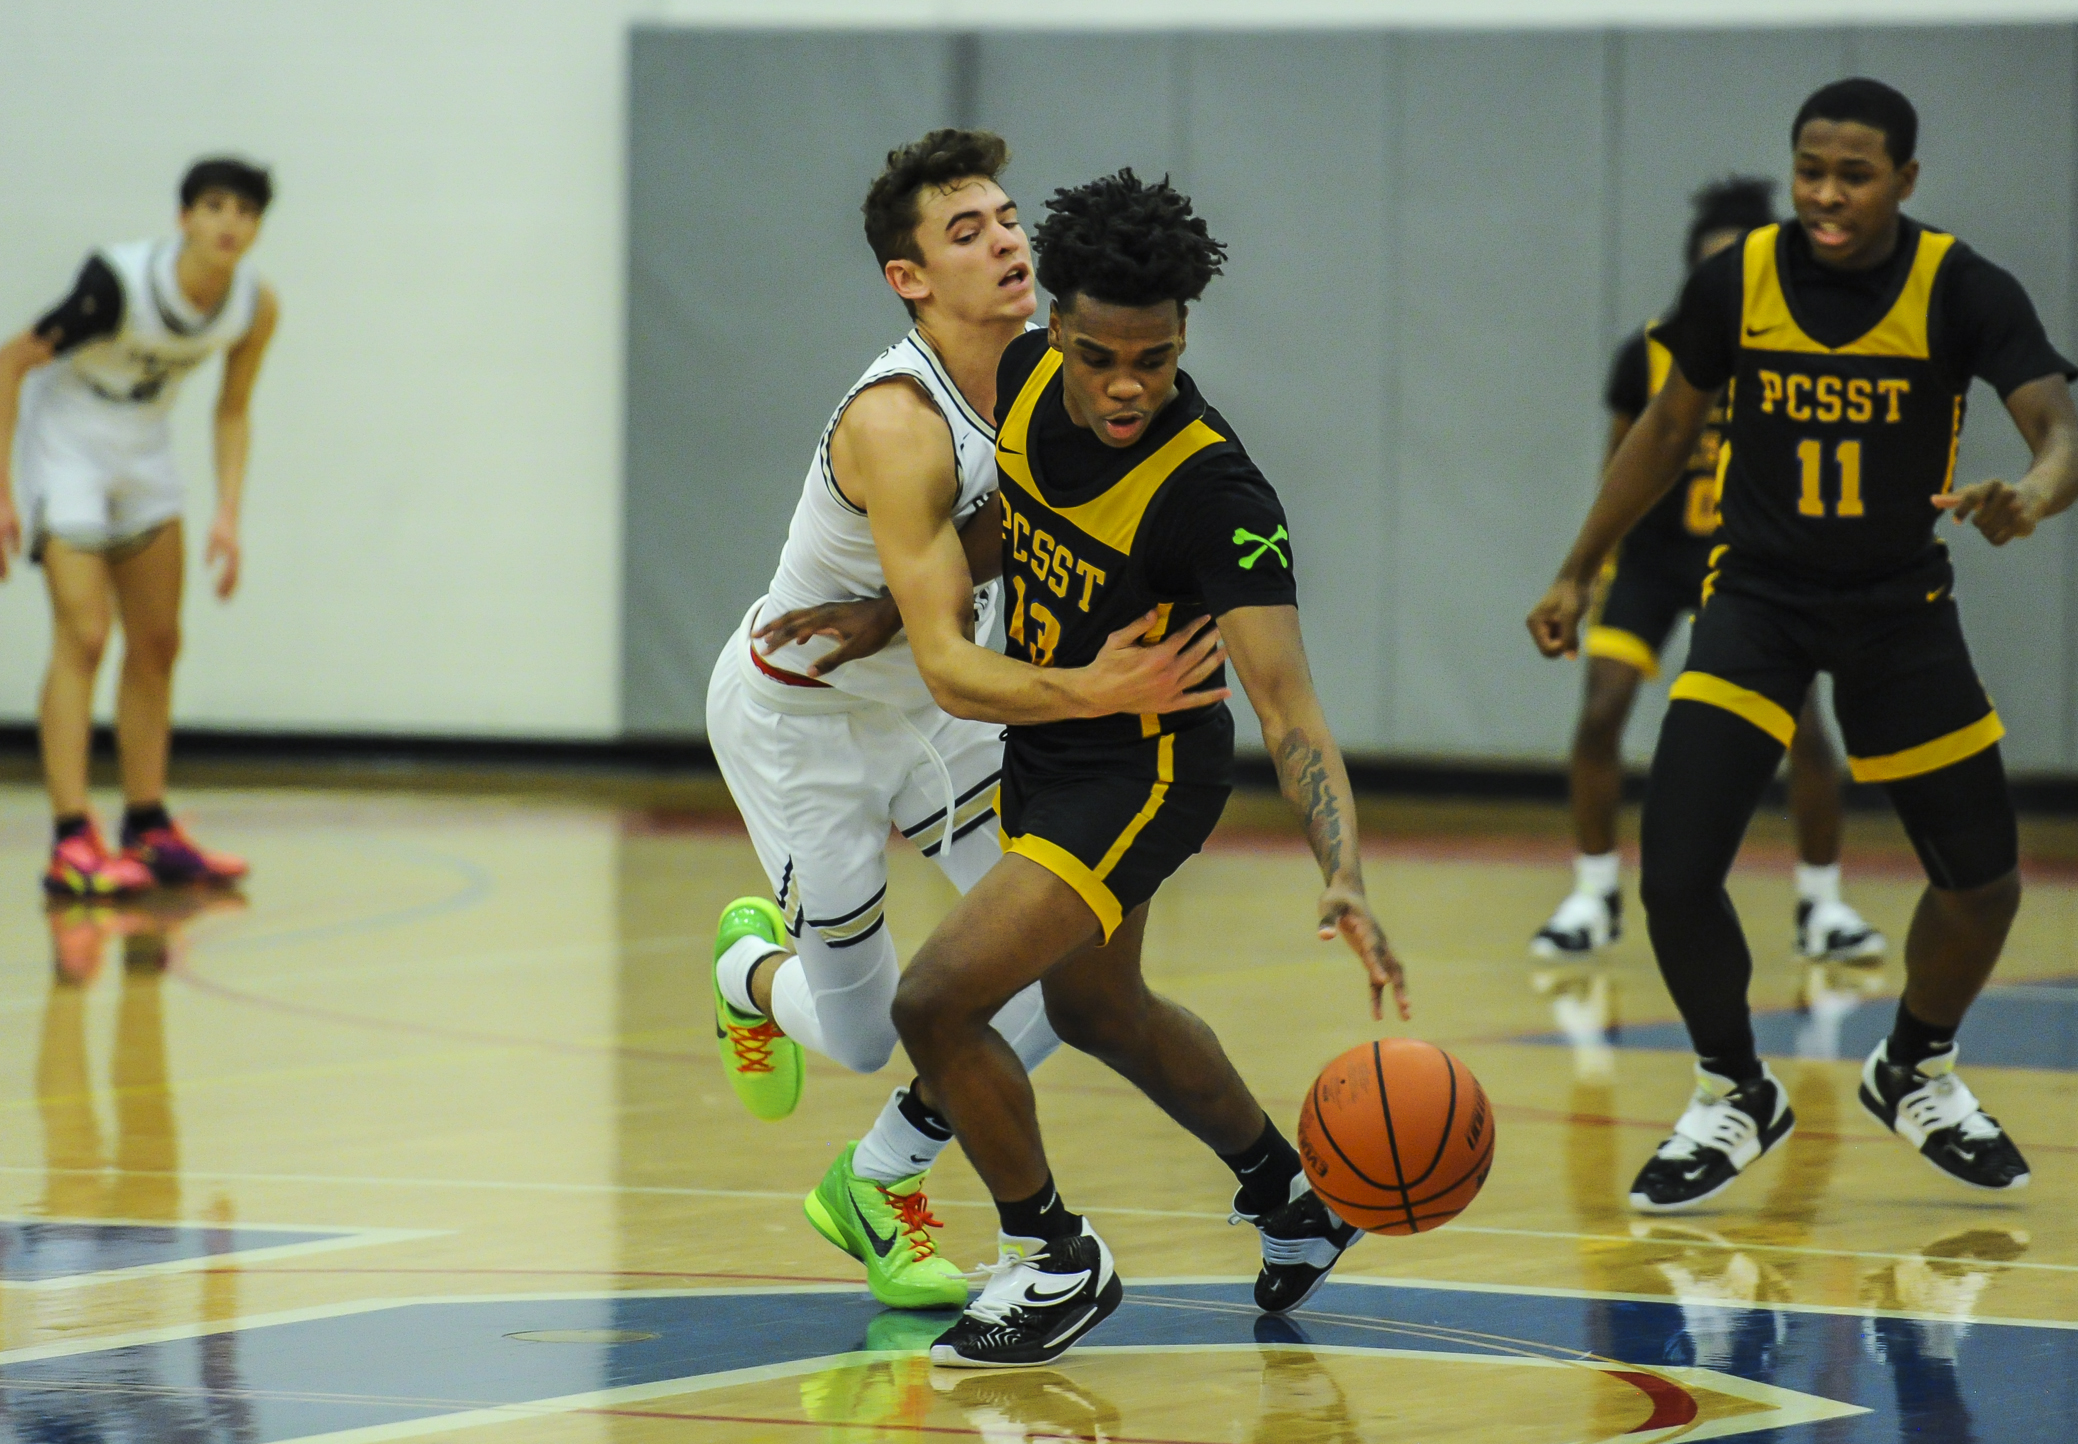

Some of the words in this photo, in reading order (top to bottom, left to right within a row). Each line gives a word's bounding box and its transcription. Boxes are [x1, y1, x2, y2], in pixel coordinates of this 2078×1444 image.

[1758, 368, 1911, 424] PCSST
[1796, 438, 1864, 517] 11
[1009, 575, 1061, 667] 13
